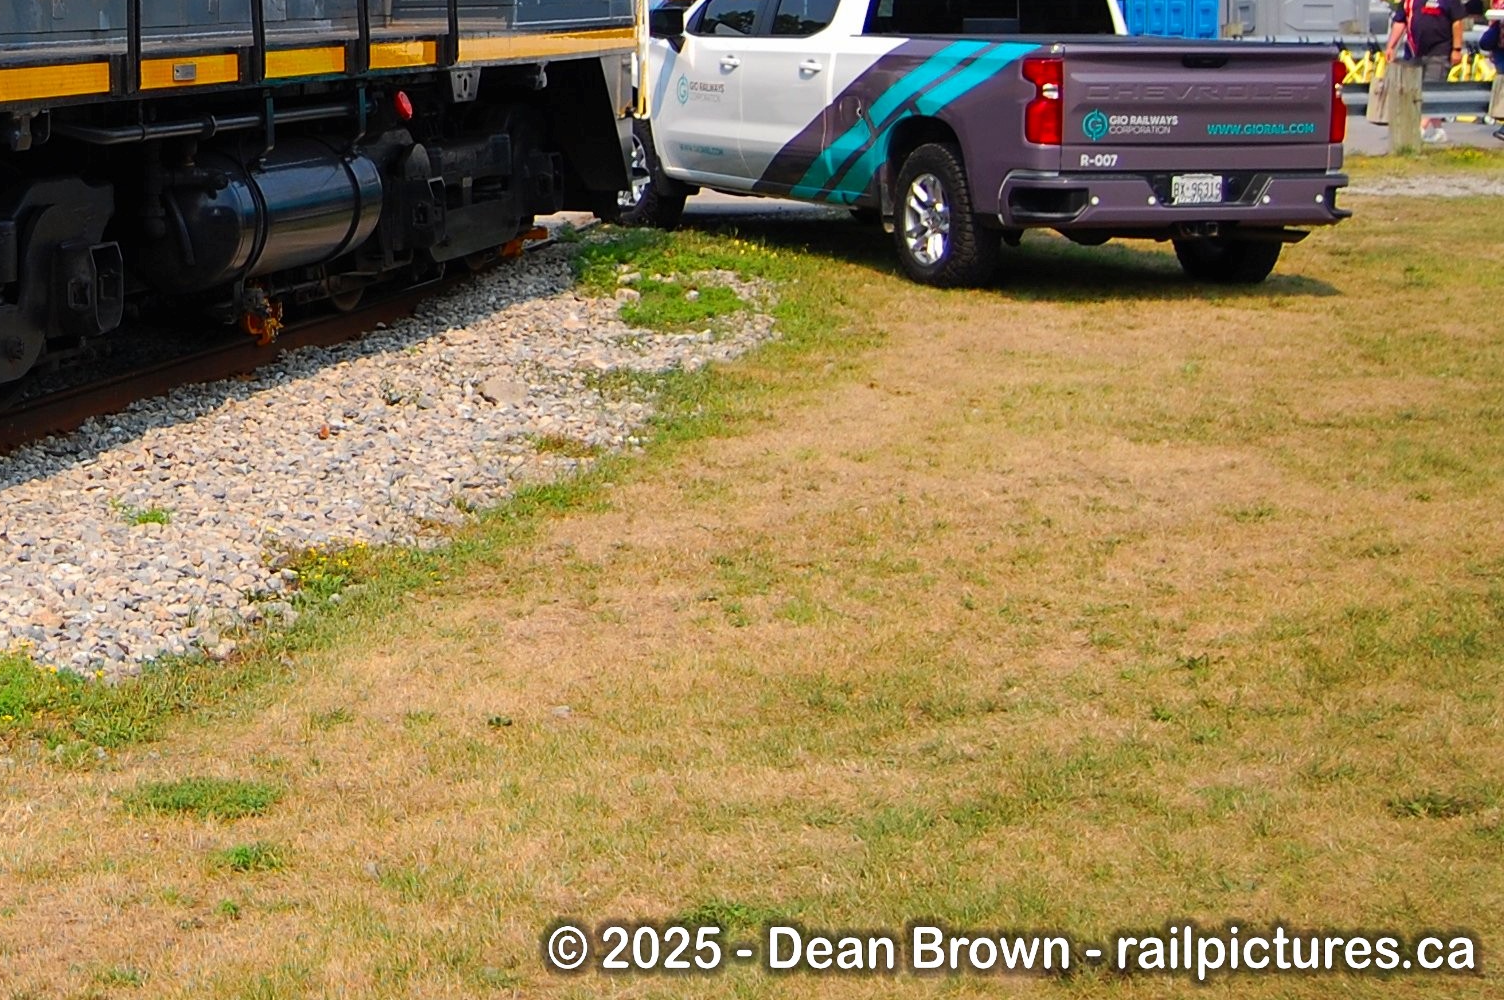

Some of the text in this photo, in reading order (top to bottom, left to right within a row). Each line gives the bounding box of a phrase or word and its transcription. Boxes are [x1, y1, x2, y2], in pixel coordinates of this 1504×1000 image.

[1086, 85, 1318, 100] CHEVROLET
[1109, 115, 1179, 126] GIO RAILWAYS
[1109, 126, 1171, 135] CORPORATION
[1207, 123, 1315, 135] WWW.GIORAIL.COM
[1080, 154, 1118, 167] R-007
